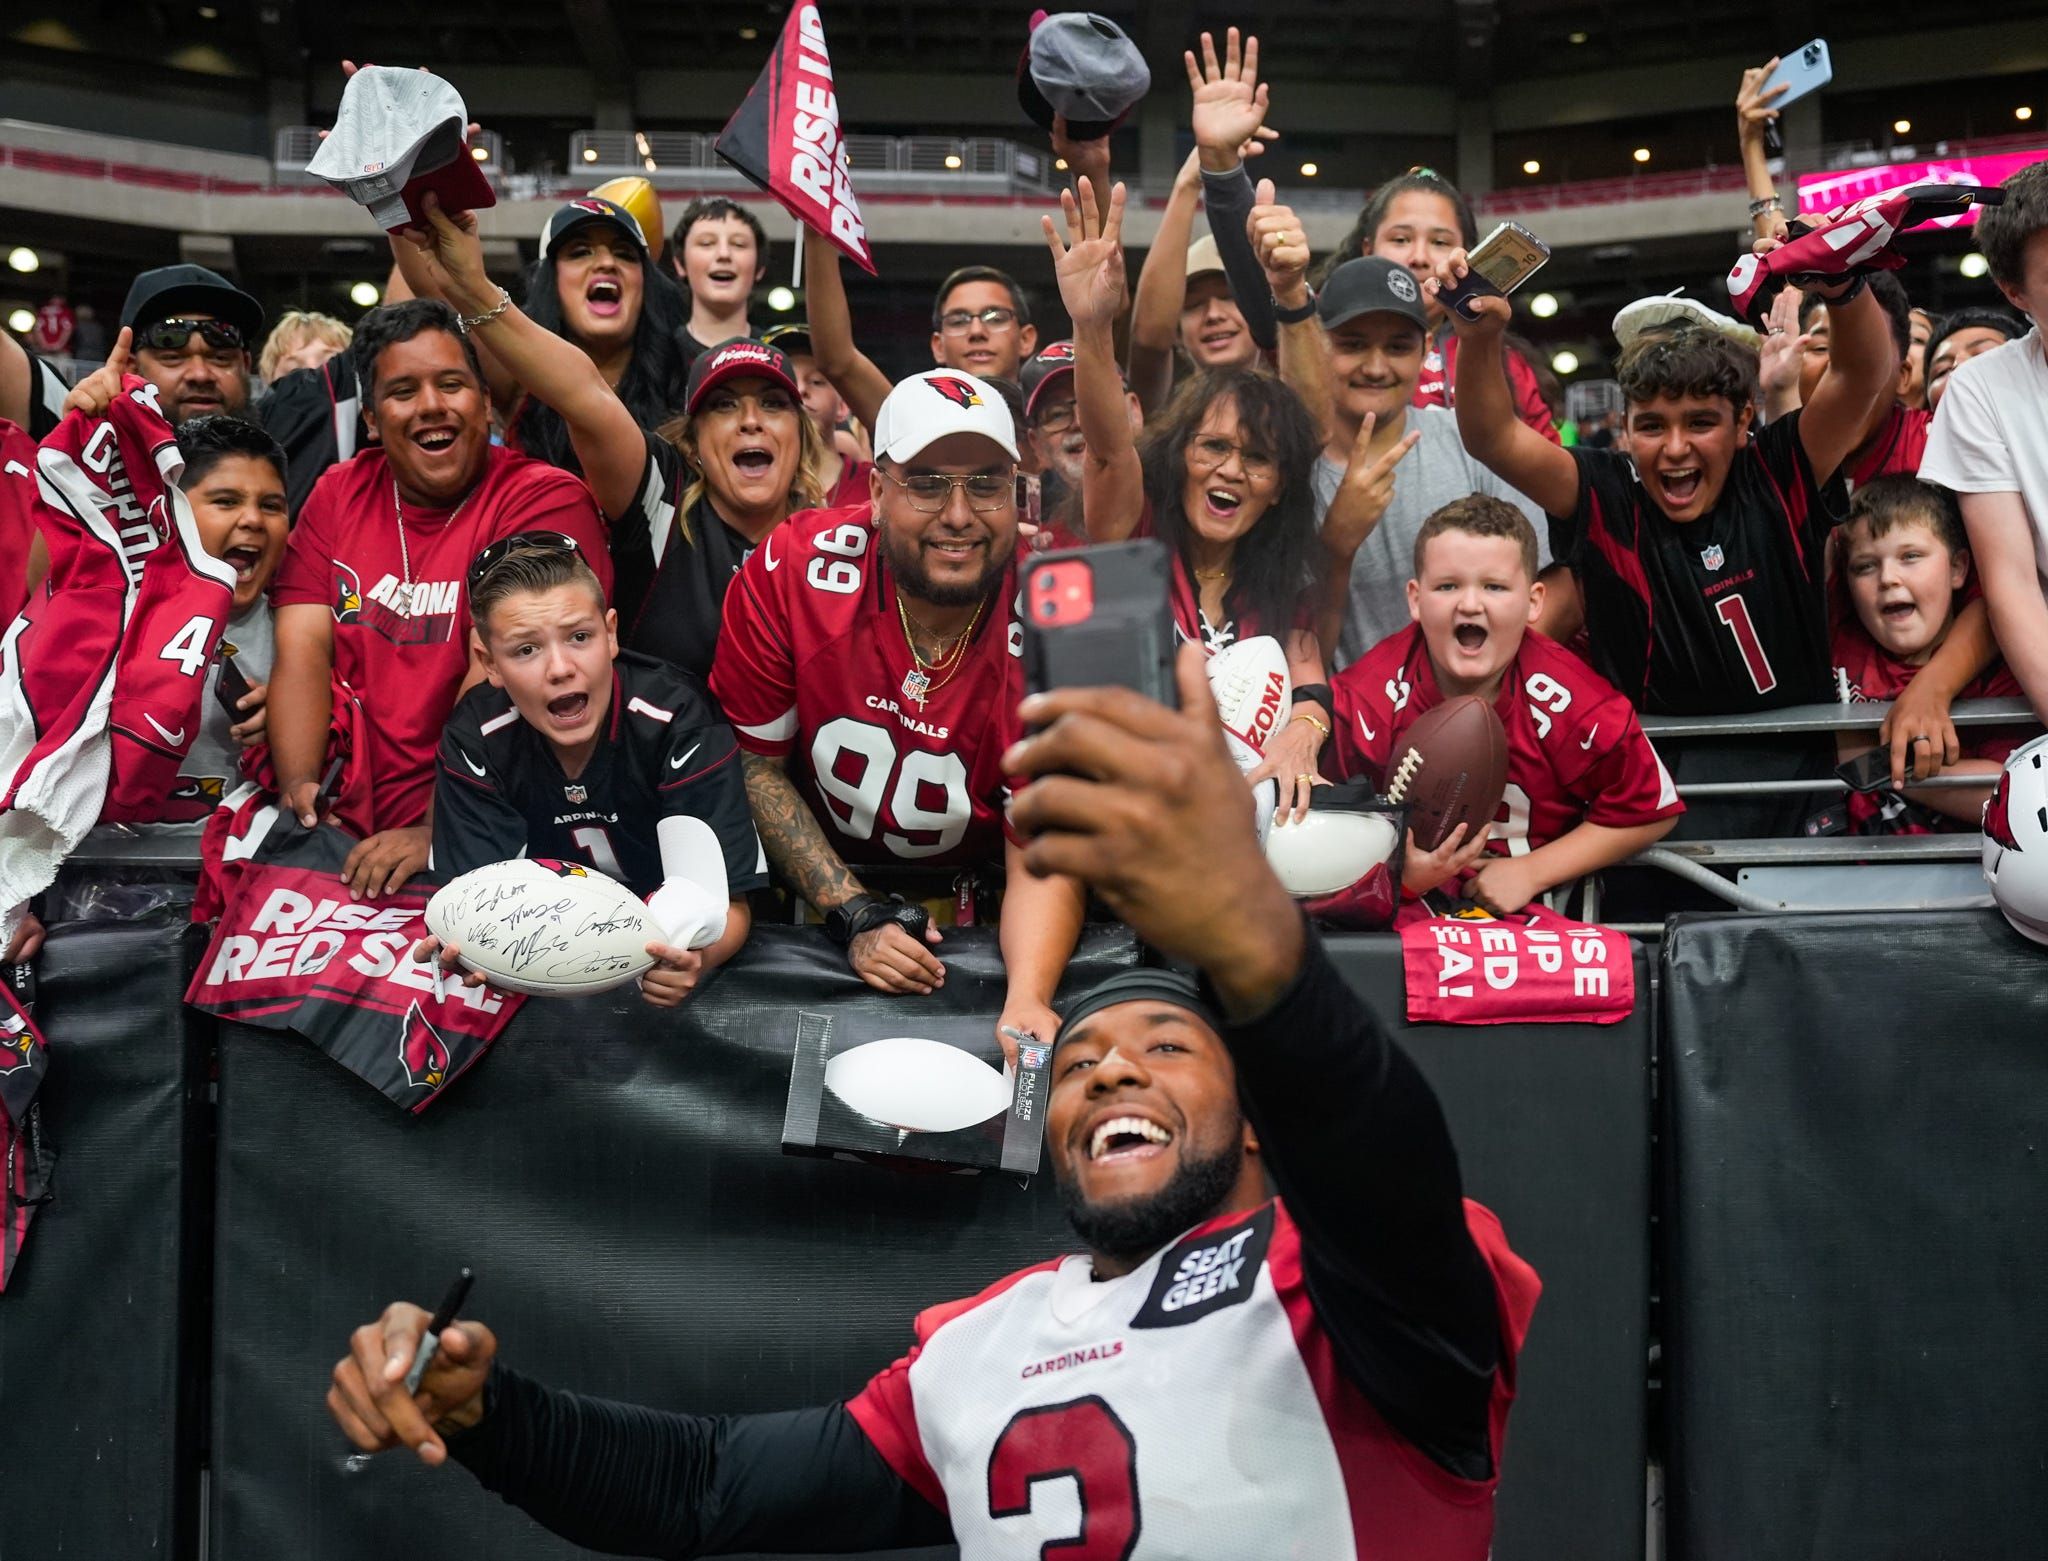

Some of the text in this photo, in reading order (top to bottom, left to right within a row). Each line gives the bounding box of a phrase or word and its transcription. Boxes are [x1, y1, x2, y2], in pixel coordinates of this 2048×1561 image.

[789, 4, 840, 209] RISE UP
[806, 524, 869, 594] 99
[366, 573, 460, 620] ARONA
[159, 615, 215, 677] 4
[1714, 593, 1777, 695] 1
[627, 696, 674, 723] 1
[865, 695, 949, 739] CARINALS
[811, 716, 972, 859] 99
[250, 888, 424, 935] RISE
[206, 931, 346, 986] RED
[1430, 925, 1474, 998] EA!
[1478, 927, 1519, 990] ED
[1019, 1072, 1030, 1119] FOOTBALL
[1023, 1073, 1036, 1121] FULL SIZE
[1173, 1228, 1254, 1282] SEAT
[1161, 1256, 1247, 1312] GEEK
[1020, 1341, 1124, 1379] CARDINALS
